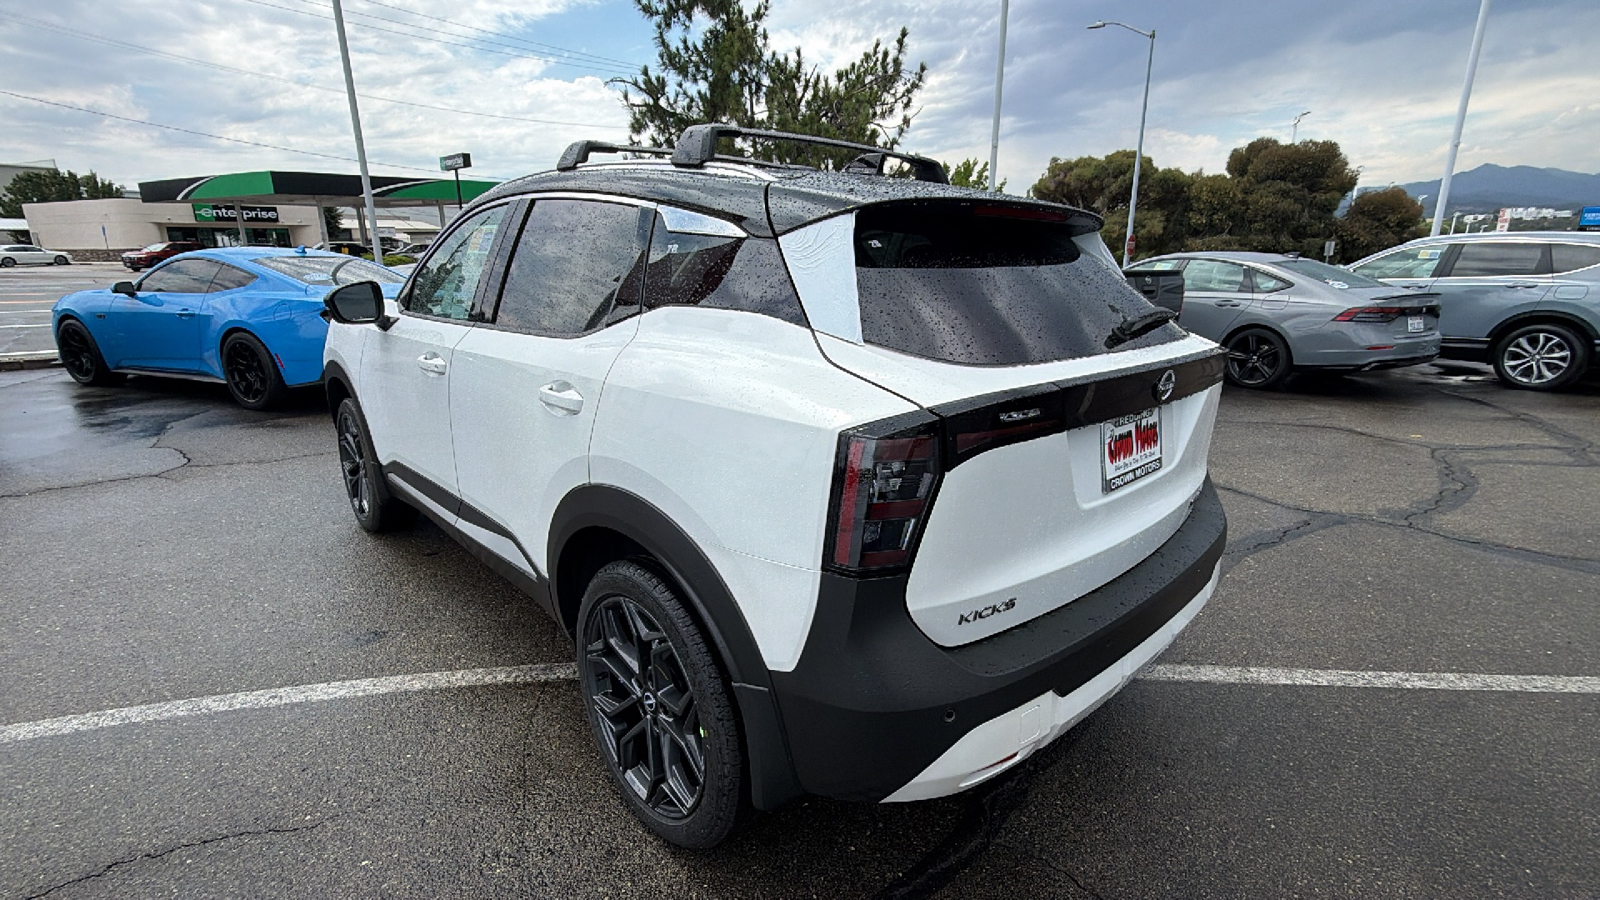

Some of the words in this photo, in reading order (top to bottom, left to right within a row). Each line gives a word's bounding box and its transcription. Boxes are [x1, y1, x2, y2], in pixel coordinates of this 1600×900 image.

[195, 207, 277, 220] enteprise
[1110, 474, 1135, 489] CROWN
[1135, 461, 1160, 477] MOTORS
[958, 597, 1017, 625] KICKS
